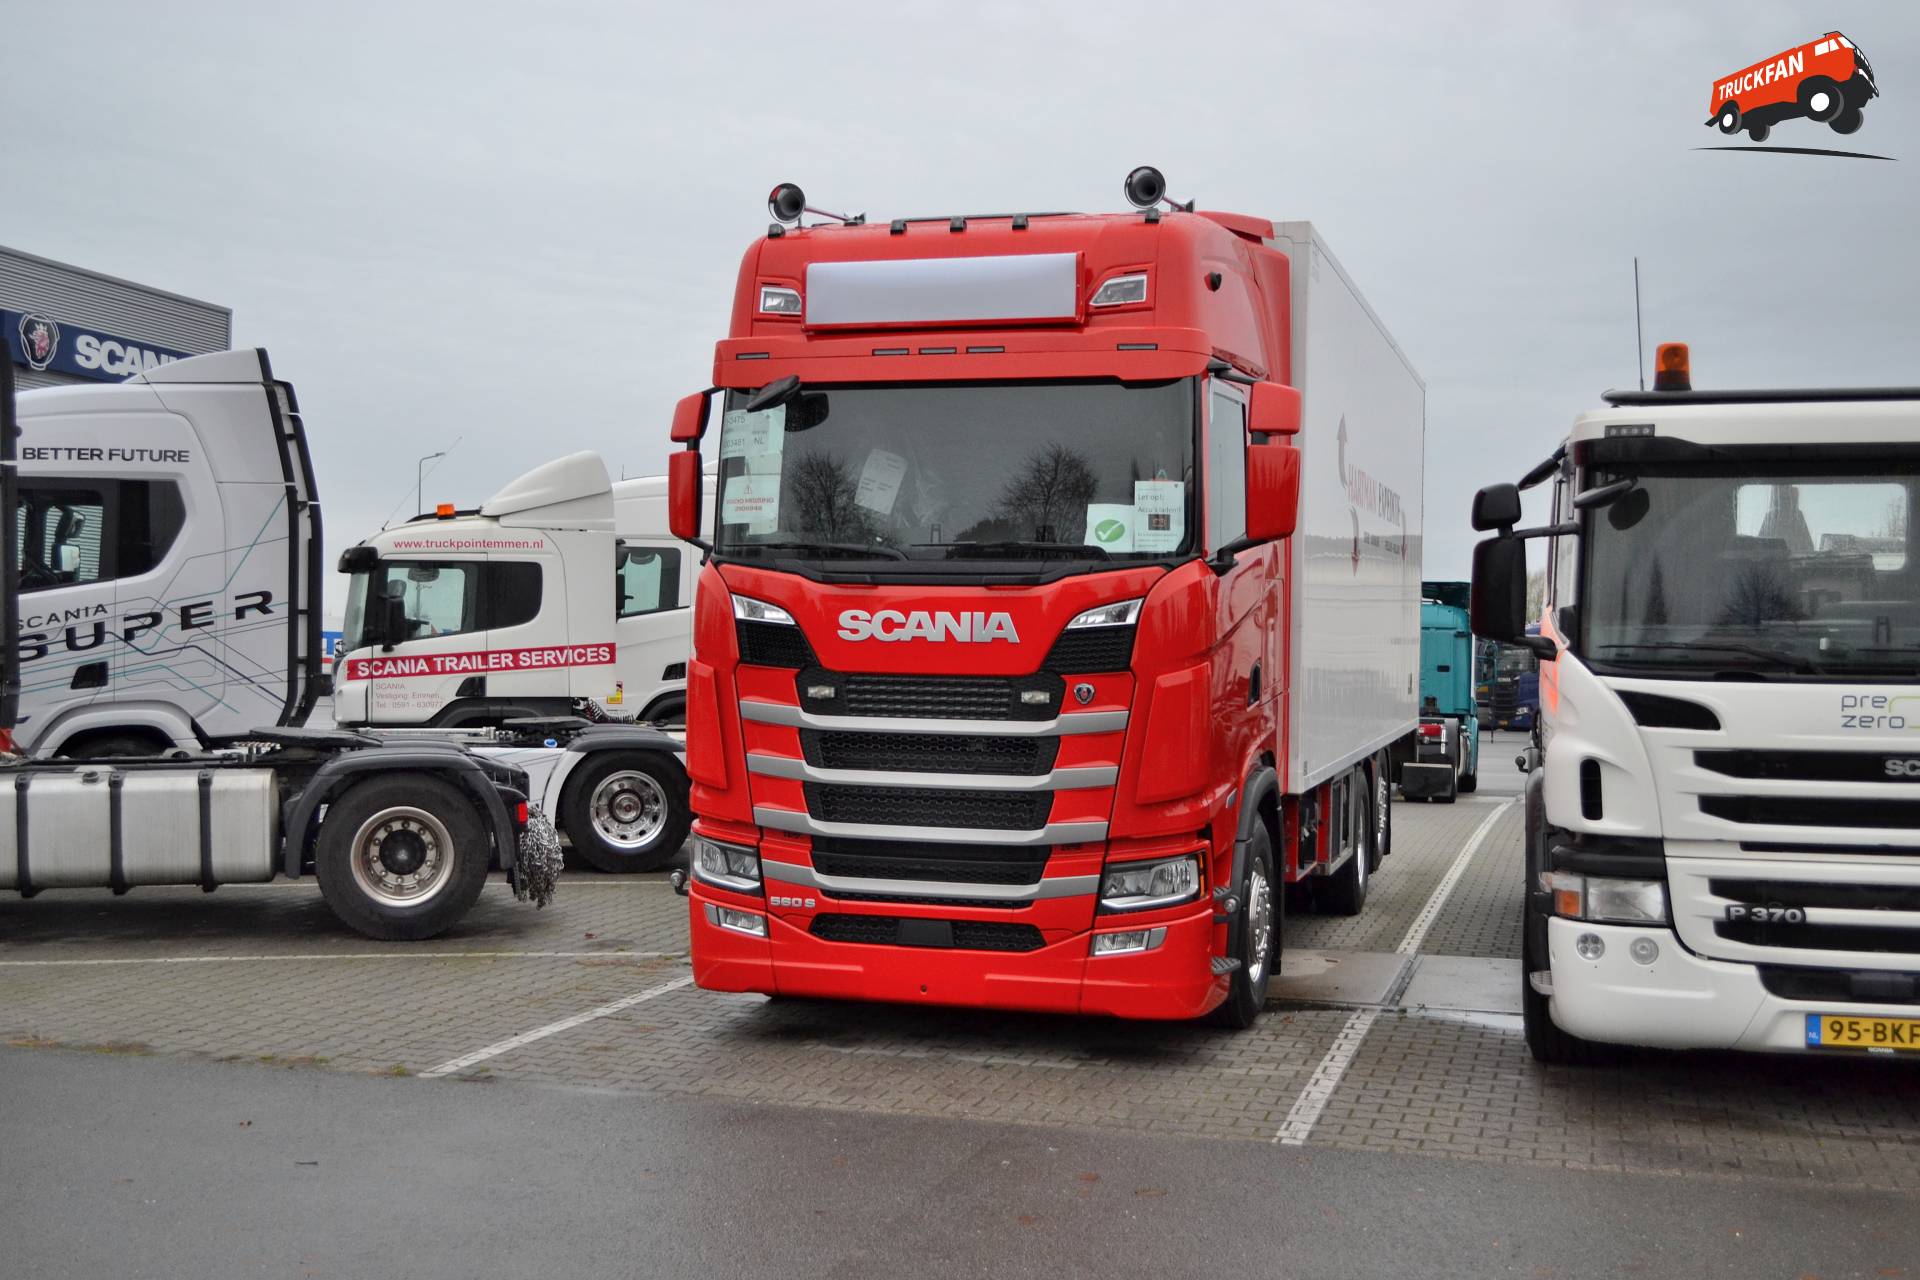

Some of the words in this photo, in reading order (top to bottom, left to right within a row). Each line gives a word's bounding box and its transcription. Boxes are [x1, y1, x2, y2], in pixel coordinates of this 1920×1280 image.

[75, 334, 178, 376] SCAN
[22, 447, 103, 461] BETTER
[108, 449, 190, 463] FUTURE
[394, 539, 543, 550] www.truckpointemmen.nl
[17, 590, 275, 663] SUPER
[837, 609, 1020, 643] SCANIA
[357, 658, 430, 678] SCANIA
[432, 652, 514, 672] TRAILER
[519, 646, 611, 667] SERVICES
[1841, 695, 1887, 711] pre
[1841, 715, 1905, 729] zero
[1730, 907, 1746, 921] P
[1751, 907, 1801, 923] 370
[1808, 1031, 1818, 1039] NL
